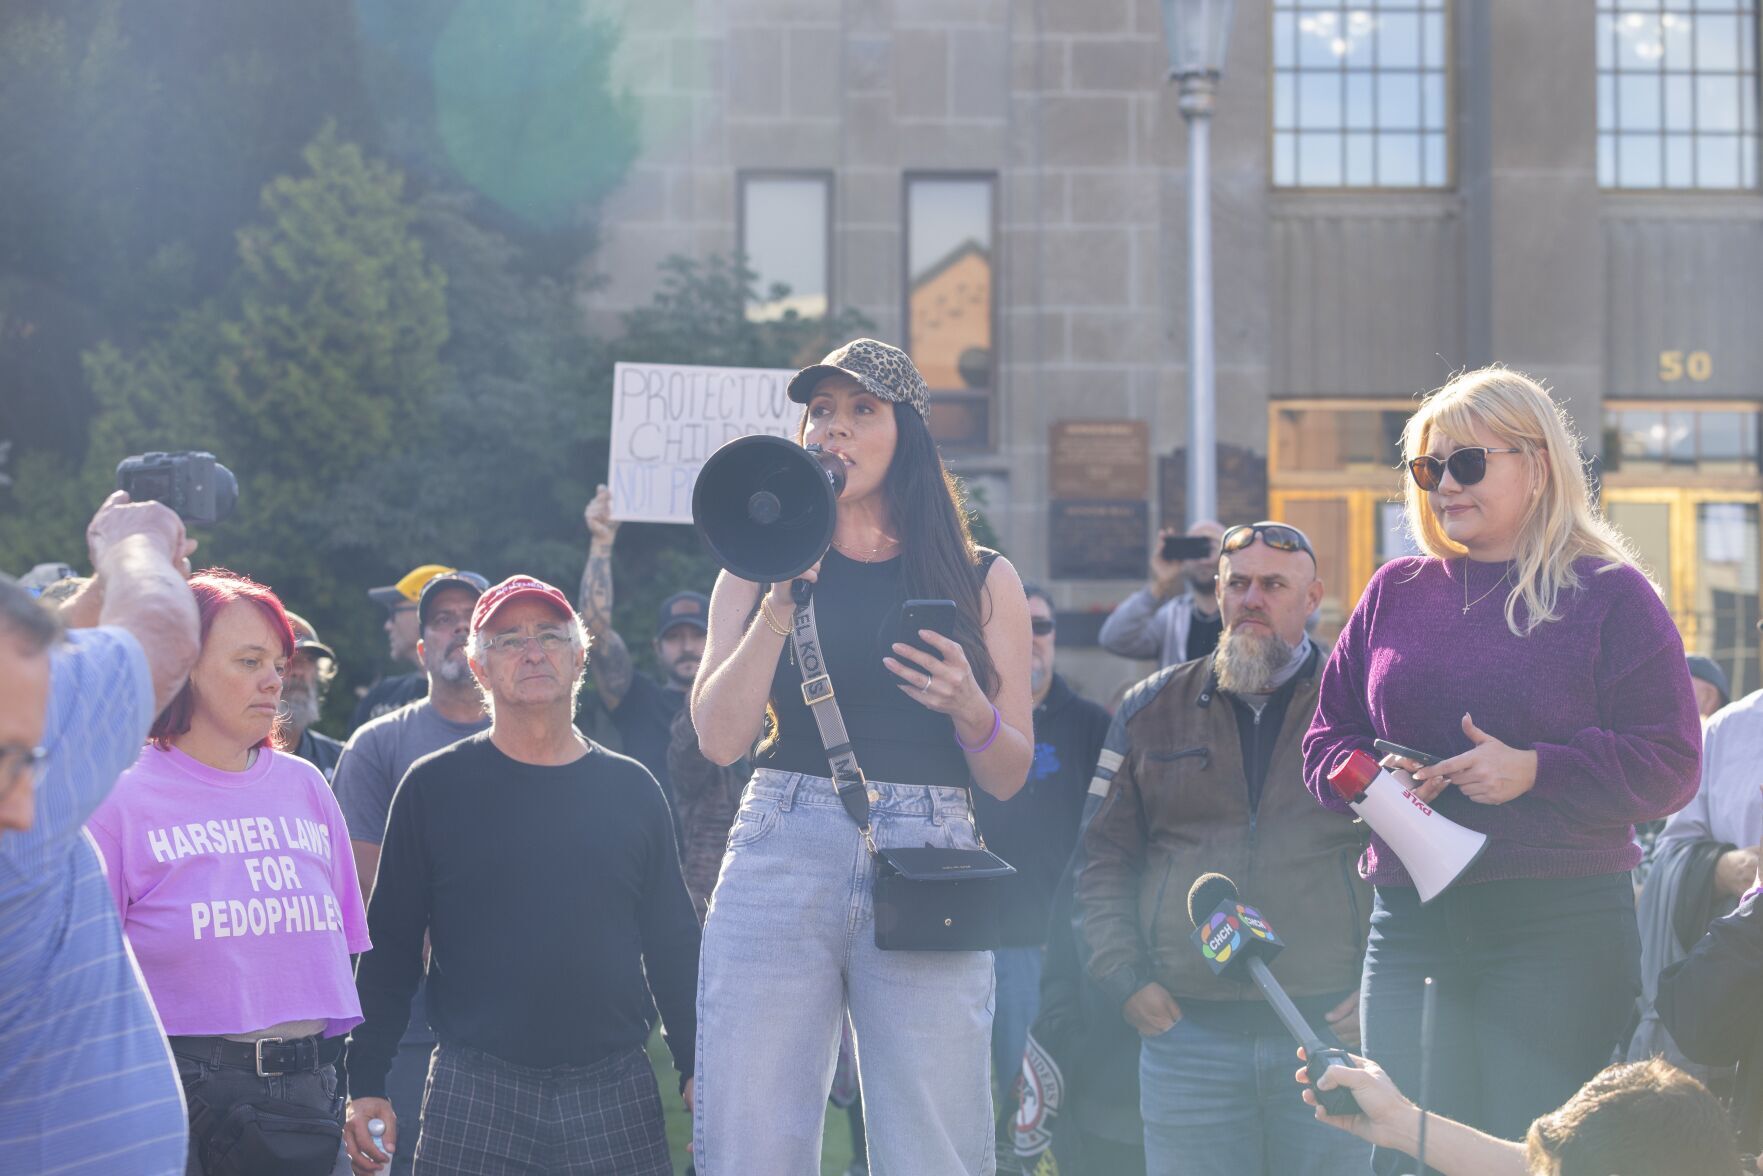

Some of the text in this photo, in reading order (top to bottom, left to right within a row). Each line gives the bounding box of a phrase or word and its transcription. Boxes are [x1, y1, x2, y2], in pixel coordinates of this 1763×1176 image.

[1658, 351, 1713, 382] 50
[619, 368, 753, 422] PROTECT
[629, 422, 789, 463] CHIL
[613, 463, 658, 514] NOT
[1402, 789, 1433, 817] PYLE
[147, 816, 332, 863] HARSHER LAWS
[244, 856, 302, 892] FOR
[1209, 922, 1233, 951] CHCH
